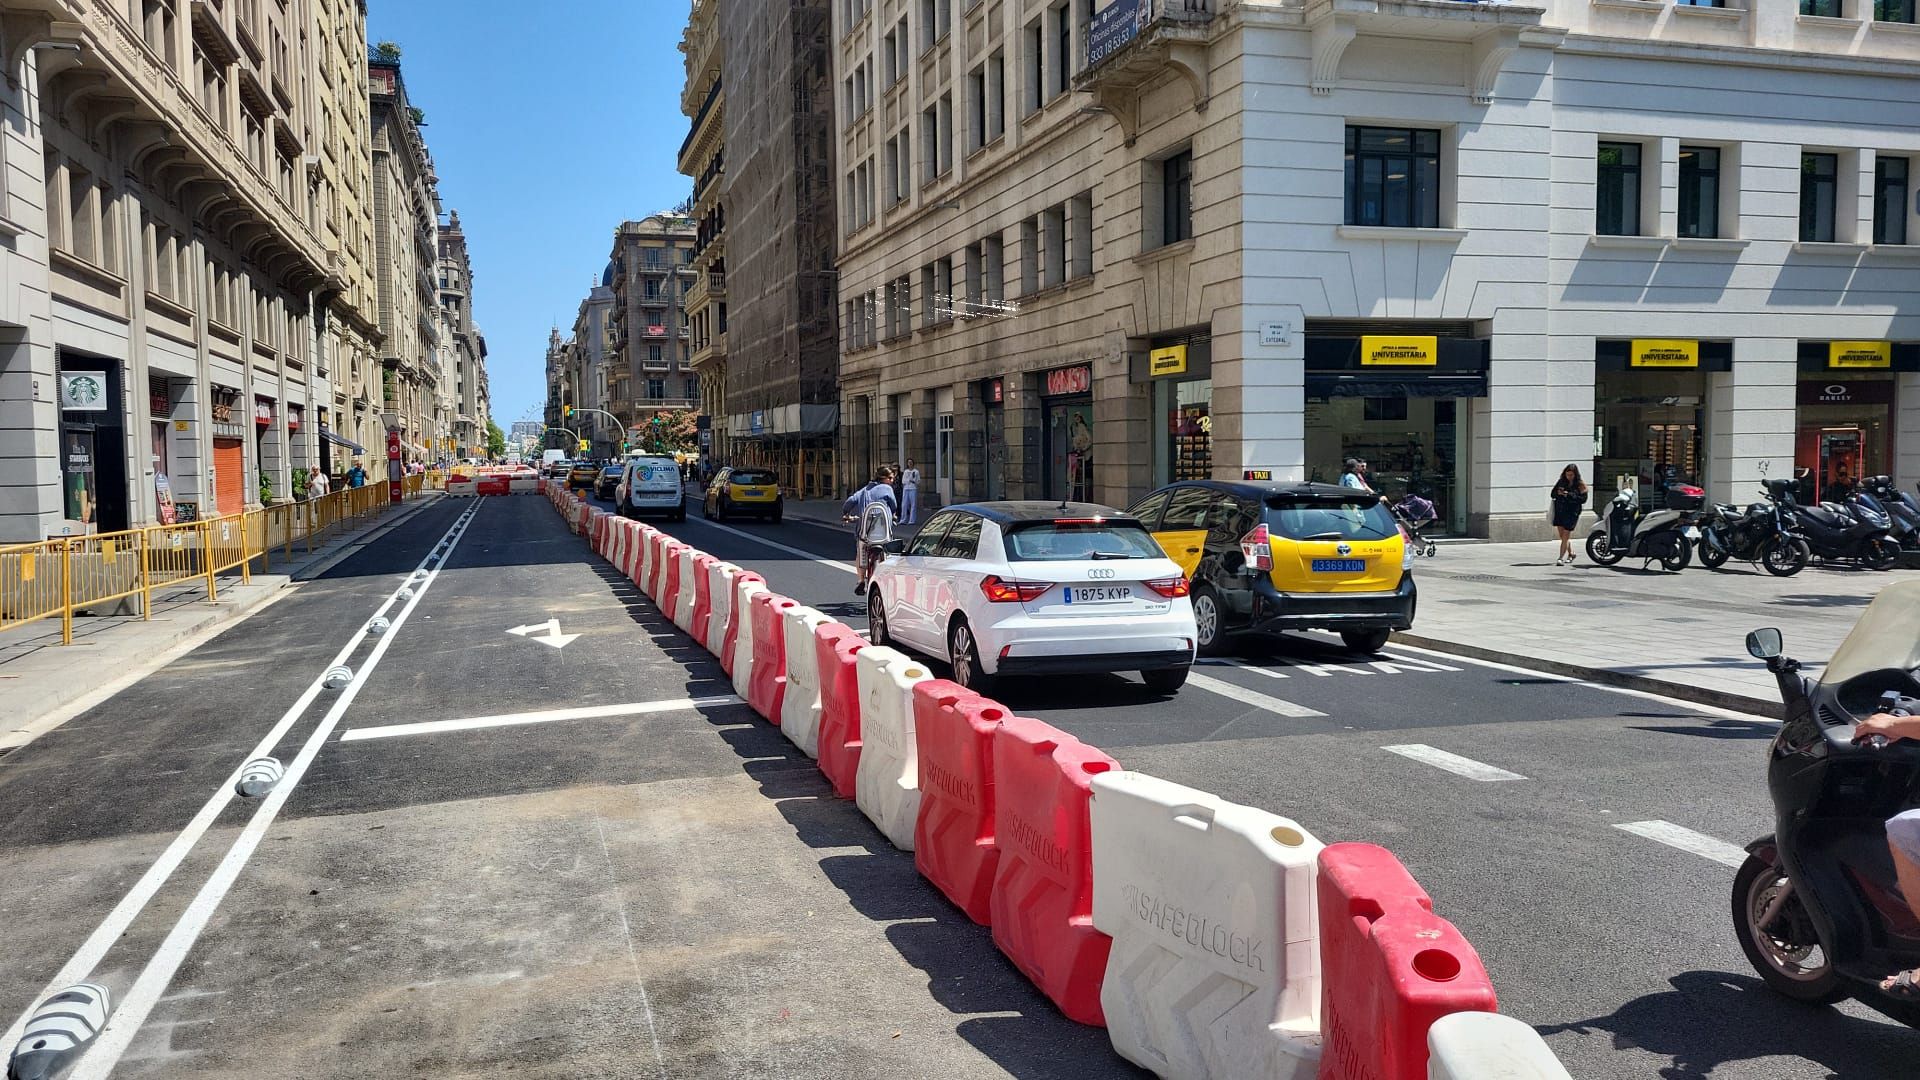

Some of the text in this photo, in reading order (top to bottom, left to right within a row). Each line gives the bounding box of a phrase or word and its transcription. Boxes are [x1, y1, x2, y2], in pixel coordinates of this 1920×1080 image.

[1091, 27, 1110, 45] Oficinas
[1105, 40, 1113, 55] 18
[1372, 351, 1427, 359] UNIVERSITARIA
[1641, 353, 1690, 361] UNIVERSITARIA
[1254, 471, 1270, 481] TAXI
[1319, 560, 1366, 571] 3369 KDN
[1075, 587, 1131, 601] 1875 KYP
